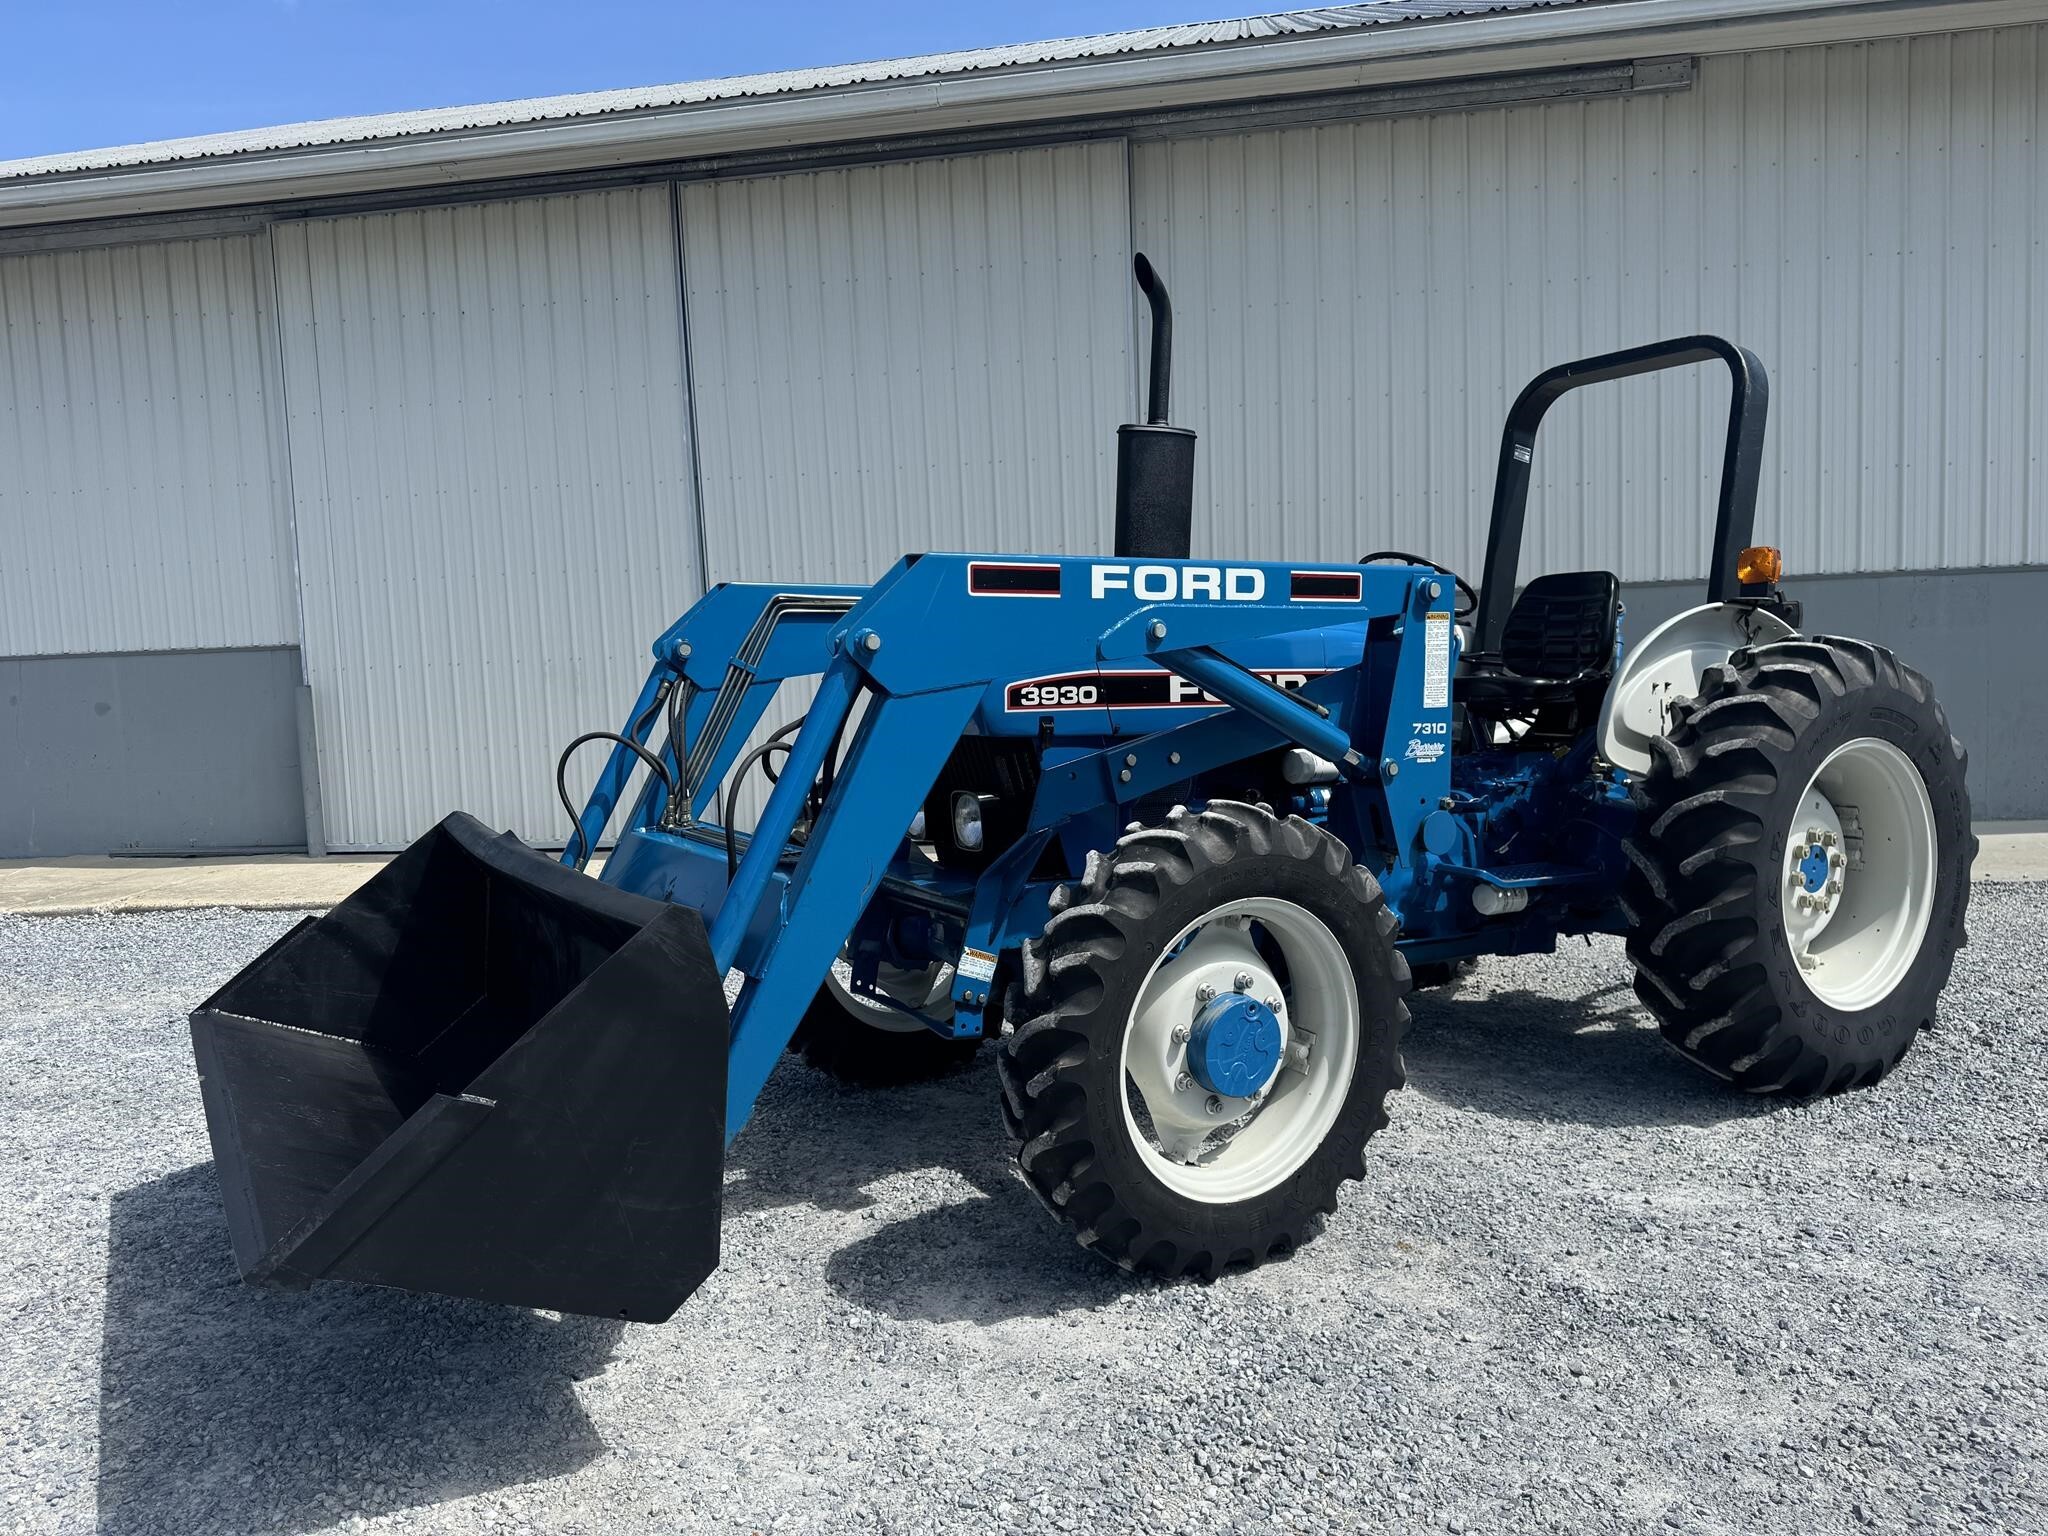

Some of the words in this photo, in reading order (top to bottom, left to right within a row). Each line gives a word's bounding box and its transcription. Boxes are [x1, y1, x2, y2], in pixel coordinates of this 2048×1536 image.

[1091, 564, 1265, 601] FORD
[1020, 685, 1097, 706] 3930
[1413, 723, 1447, 735] 7310
